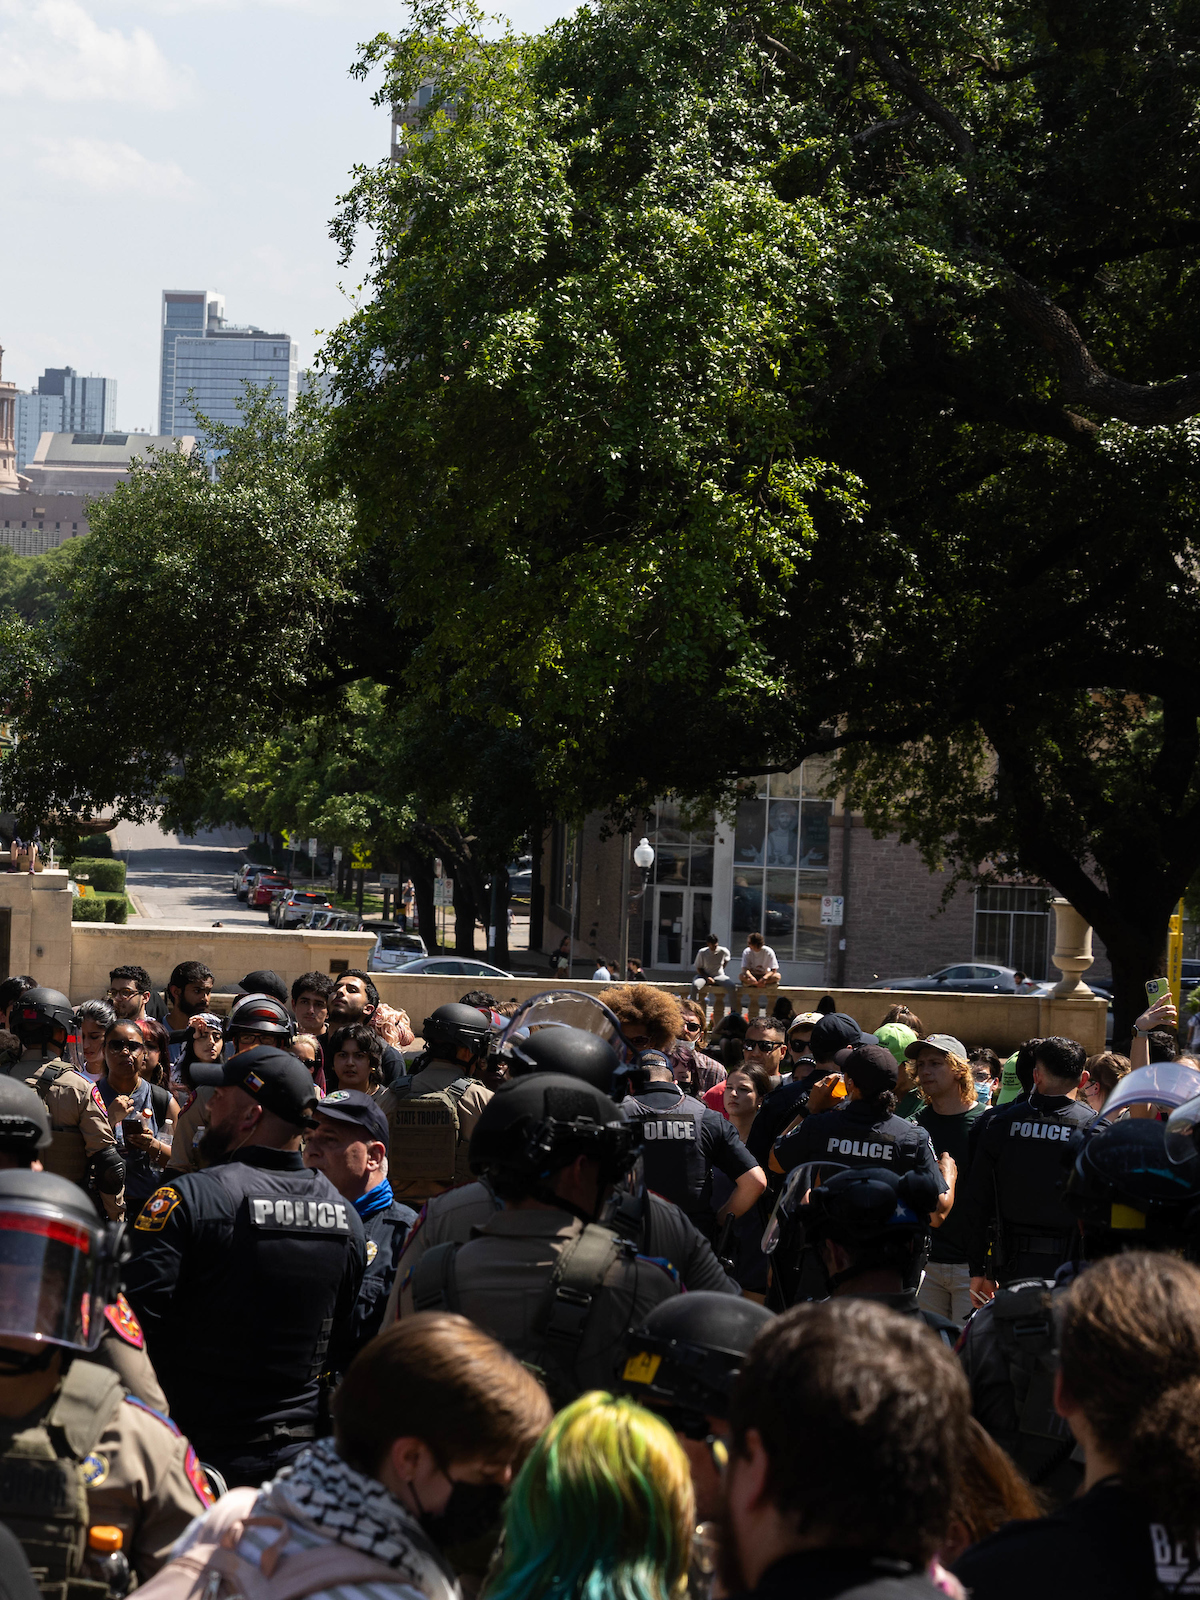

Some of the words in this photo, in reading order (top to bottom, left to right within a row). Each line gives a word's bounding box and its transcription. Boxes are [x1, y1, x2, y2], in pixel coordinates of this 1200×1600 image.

[396, 1110, 416, 1125] STATE
[417, 1110, 450, 1125] TROOPER
[643, 1120, 696, 1140] OLICE
[1009, 1121, 1071, 1142] POLICE
[826, 1137, 894, 1160] POLICE
[252, 1199, 349, 1230] POLICE
[1149, 1522, 1200, 1566] BL
